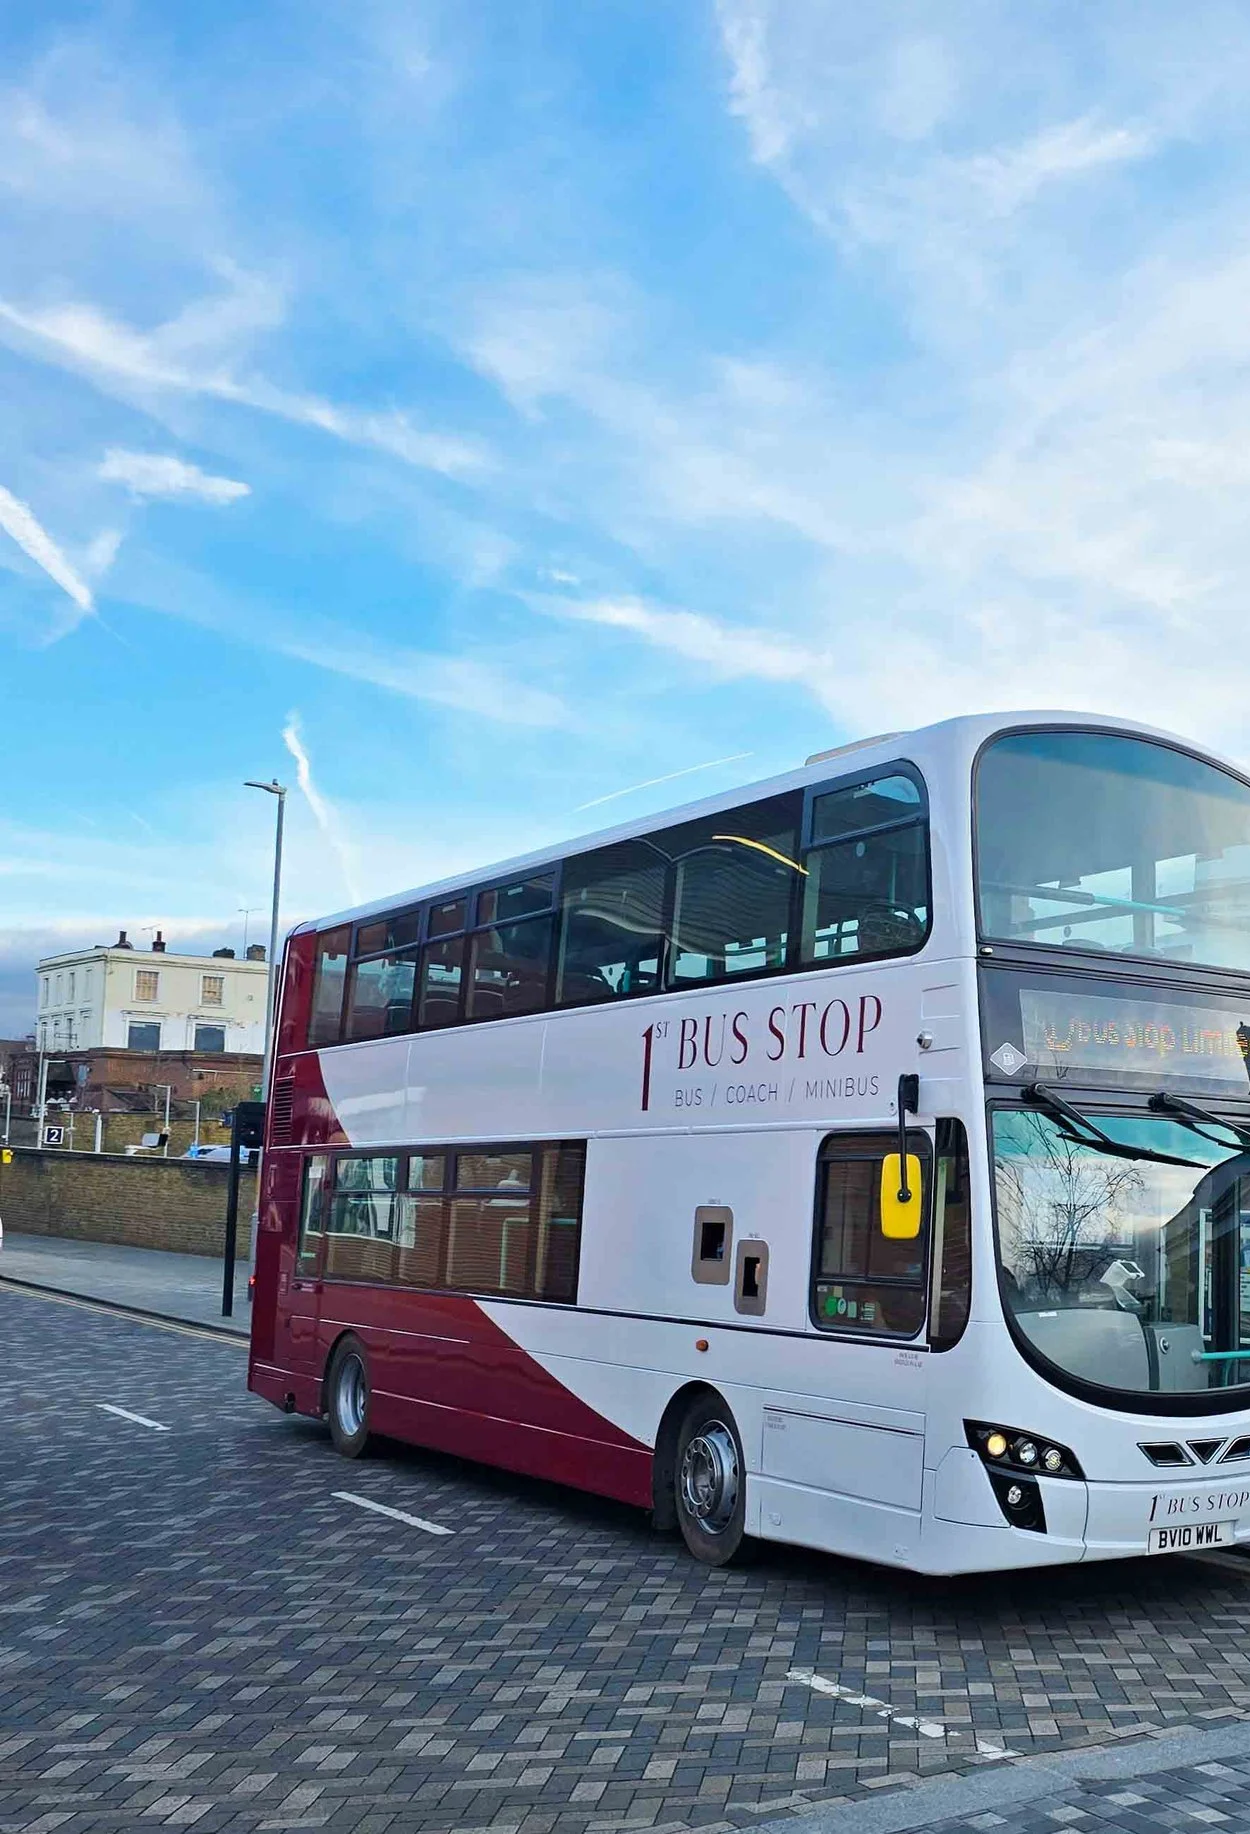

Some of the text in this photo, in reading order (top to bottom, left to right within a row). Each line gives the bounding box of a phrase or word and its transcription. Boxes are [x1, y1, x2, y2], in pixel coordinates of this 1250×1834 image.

[677, 1011, 750, 1070] BUS
[766, 995, 883, 1062] STOP
[675, 1088, 702, 1107] BUS
[725, 1082, 778, 1105] COACH
[805, 1075, 879, 1100] MINIBUS
[50, 1130, 59, 1142] 2
[1168, 1496, 1200, 1514] BUS
[1207, 1491, 1250, 1511] STOP
[1158, 1524, 1222, 1549] BV10 WWL
